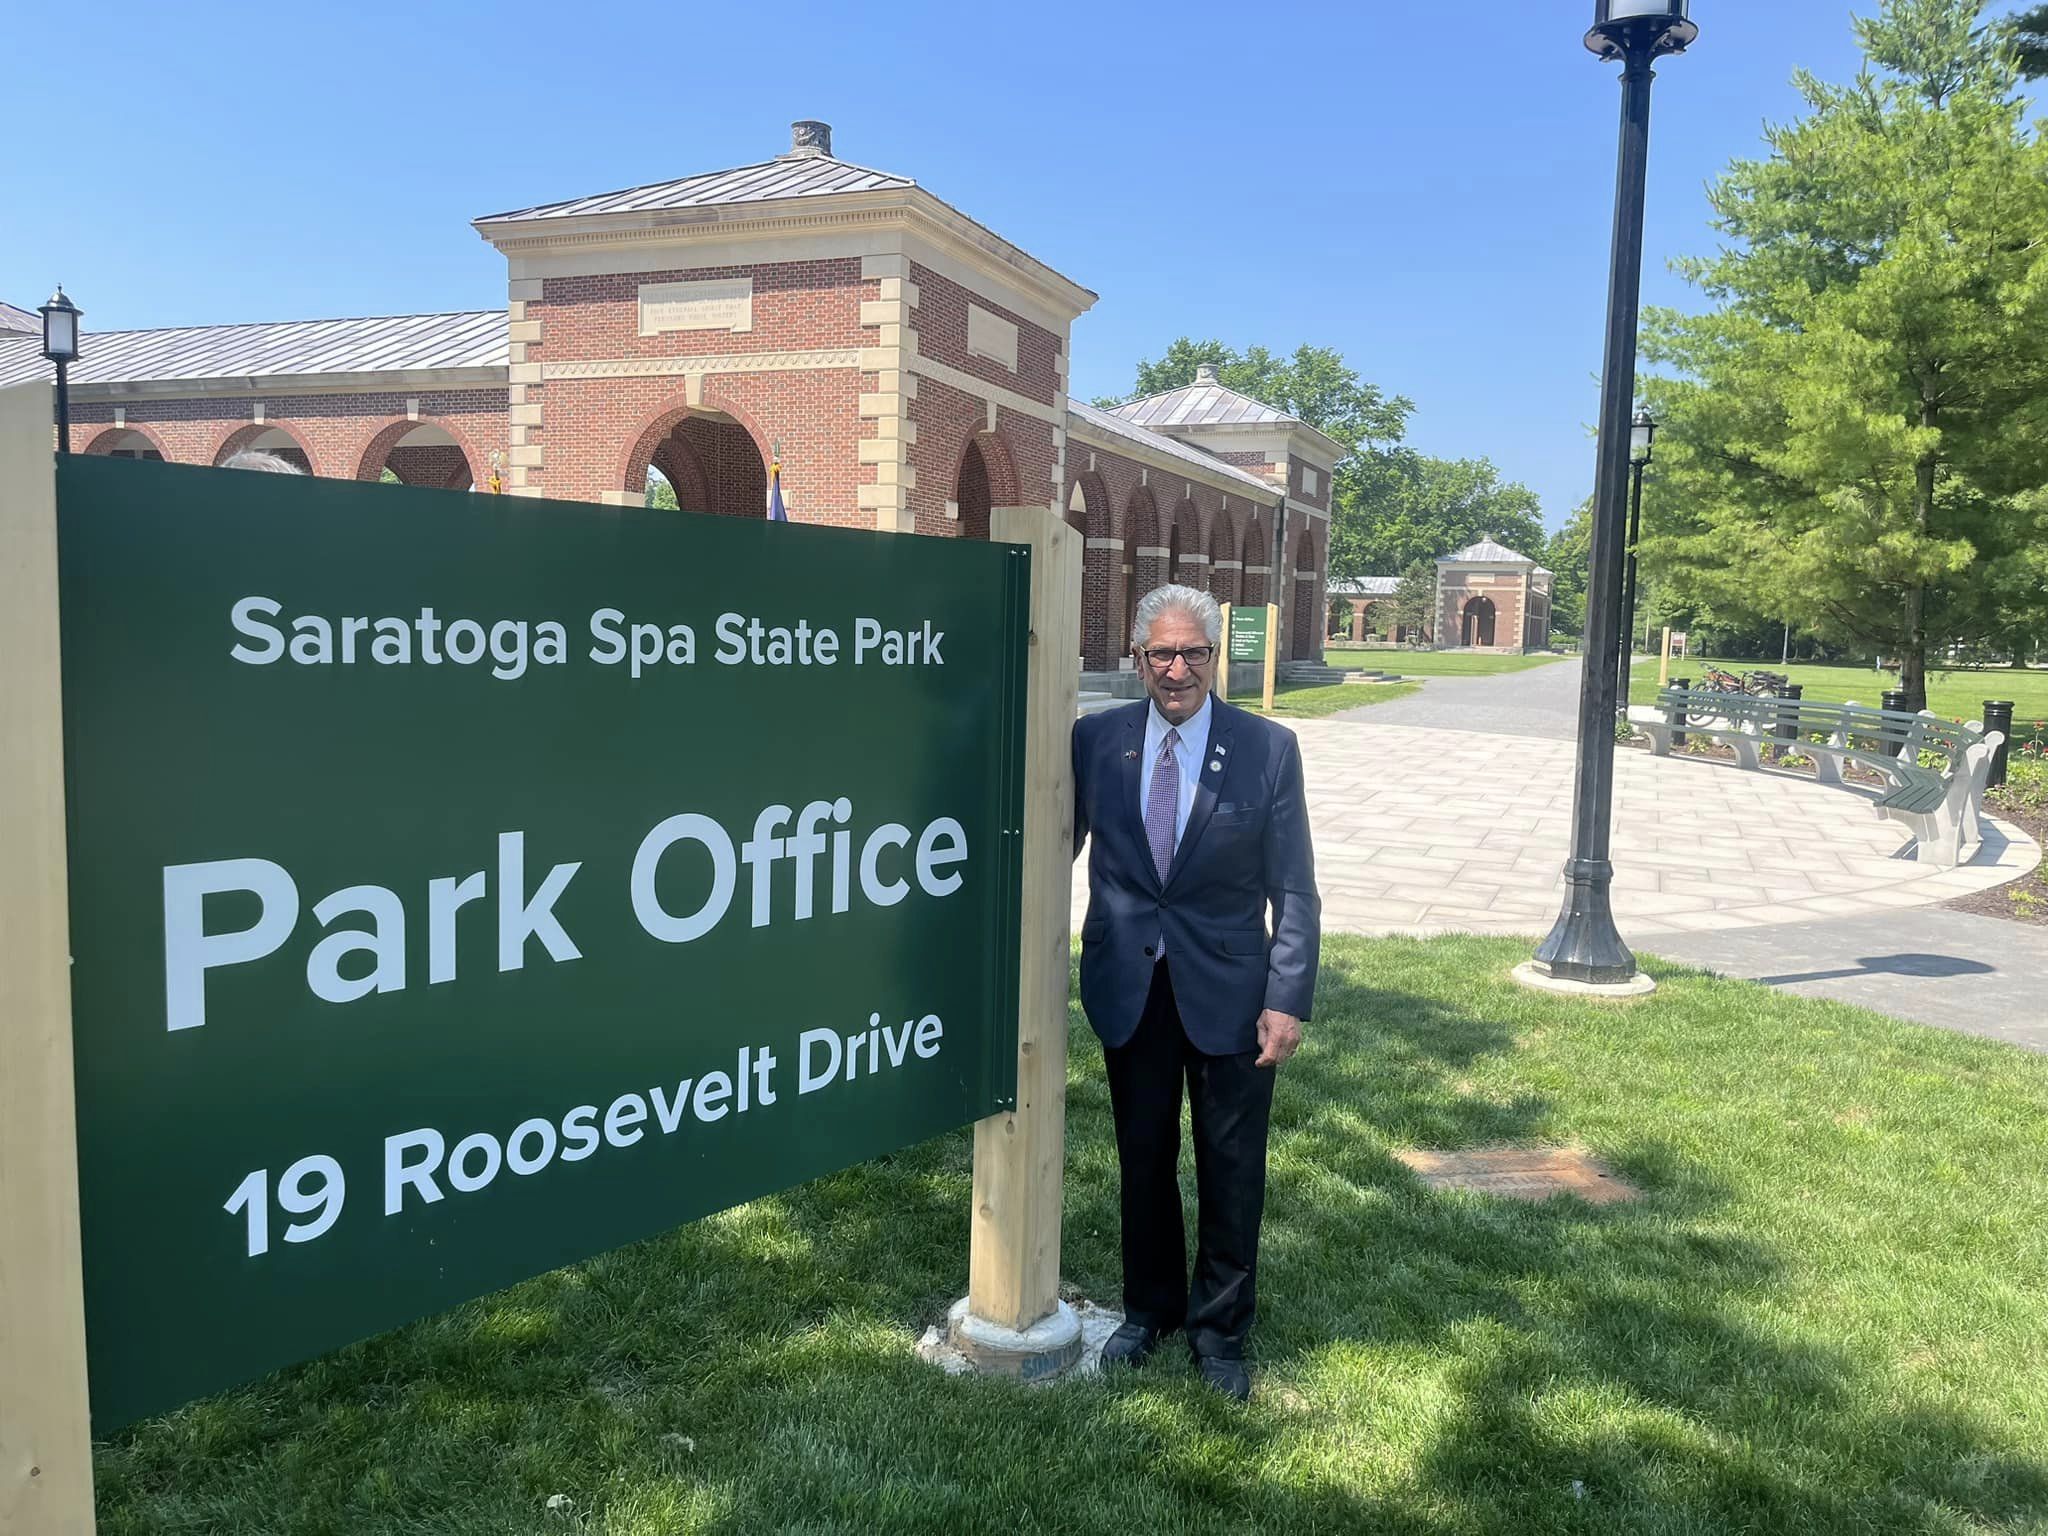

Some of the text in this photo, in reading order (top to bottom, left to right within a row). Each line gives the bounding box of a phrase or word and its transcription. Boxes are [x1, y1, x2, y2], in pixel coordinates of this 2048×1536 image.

[230, 596, 945, 681] Saratoga Spa State Park
[163, 796, 968, 1032] Park Office
[222, 1012, 943, 1258] 19 Roosevelt Drive
